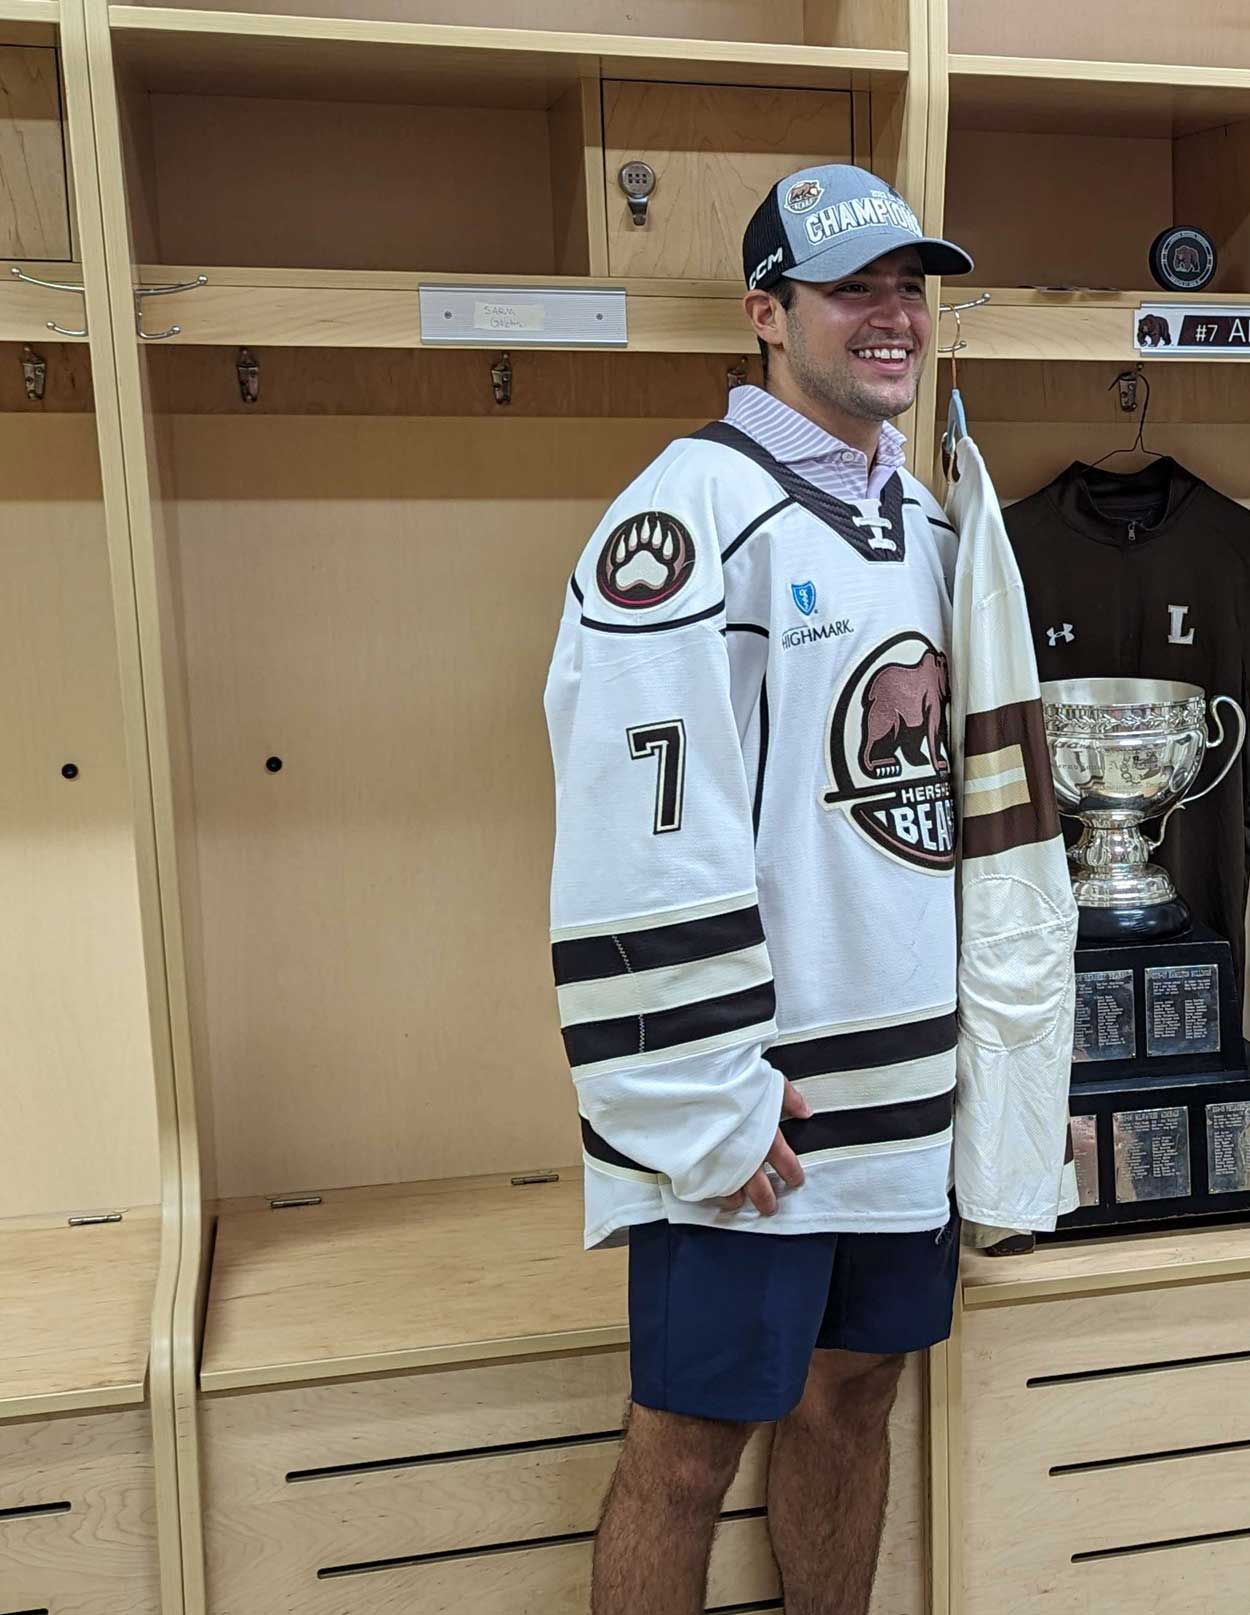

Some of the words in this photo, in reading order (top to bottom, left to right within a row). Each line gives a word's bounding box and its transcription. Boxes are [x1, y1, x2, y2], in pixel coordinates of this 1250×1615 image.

[804, 196, 923, 244] CHAMPIONS
[749, 246, 783, 290] CCM
[1195, 324, 1218, 342] #7
[1167, 604, 1195, 645] L
[626, 719, 686, 835] 7
